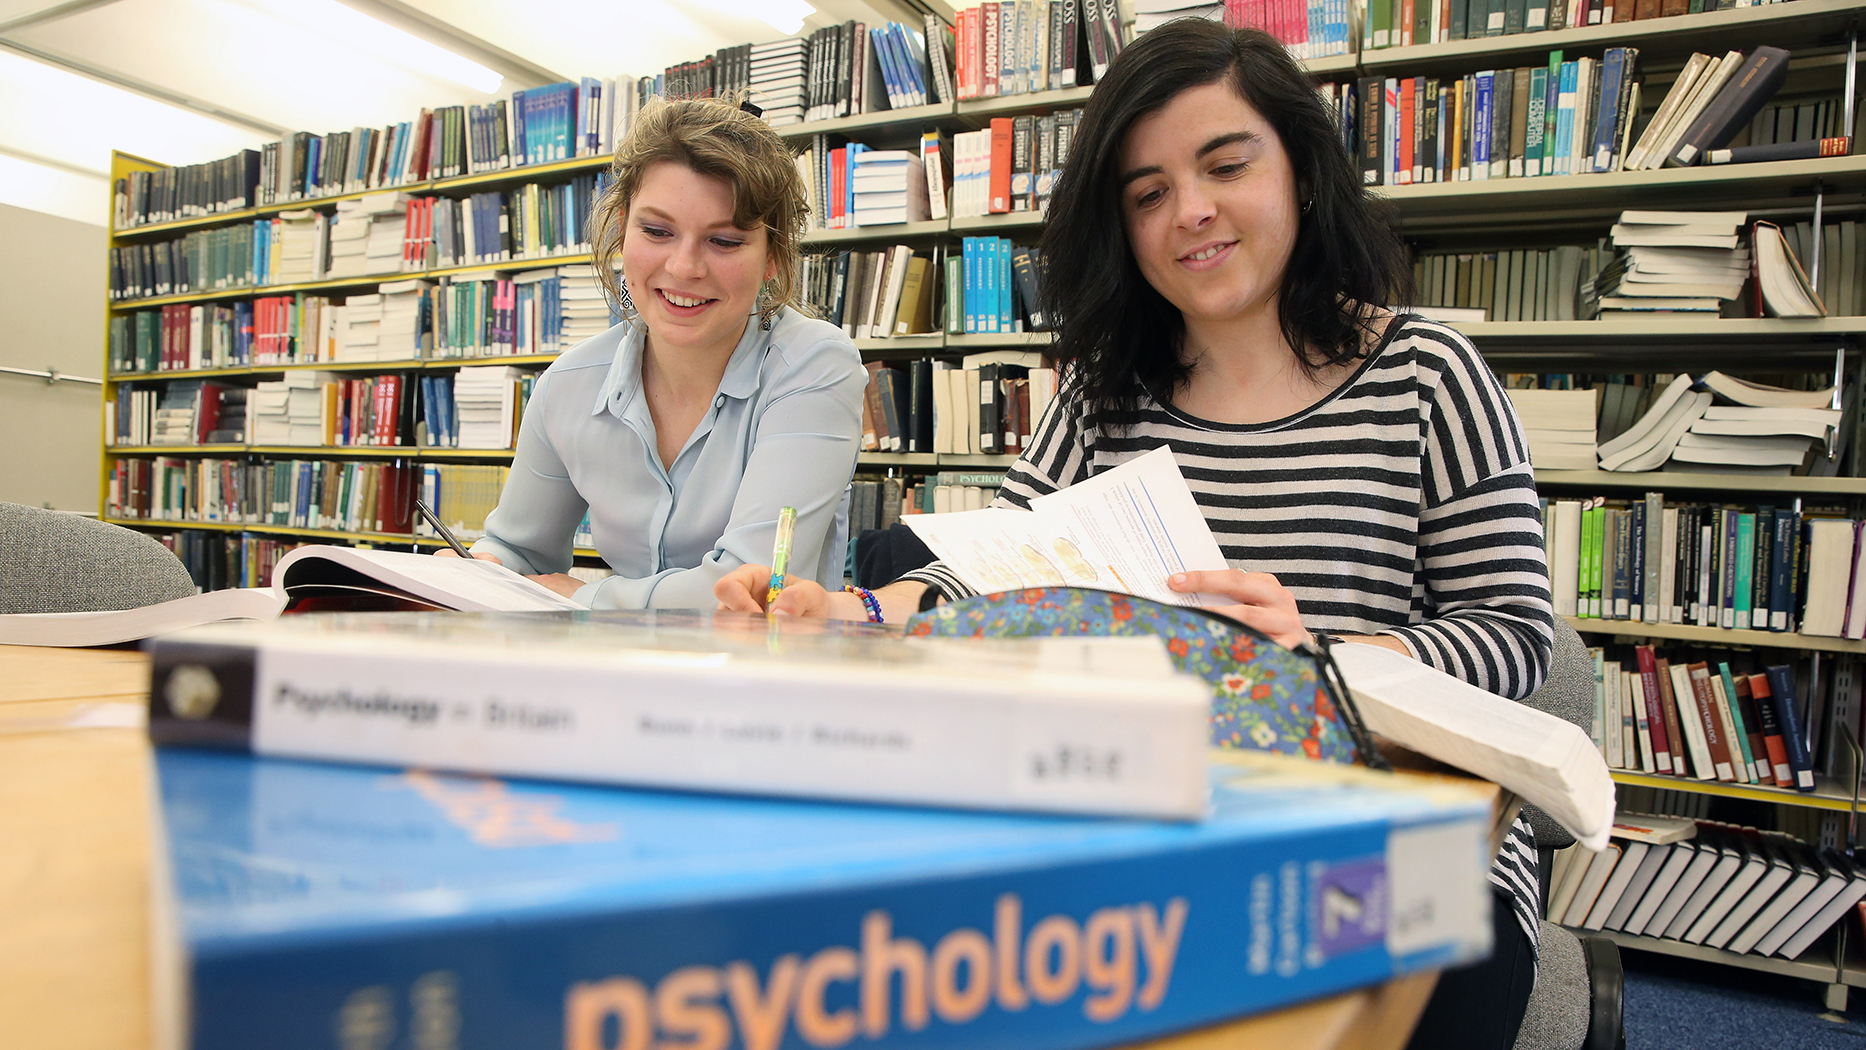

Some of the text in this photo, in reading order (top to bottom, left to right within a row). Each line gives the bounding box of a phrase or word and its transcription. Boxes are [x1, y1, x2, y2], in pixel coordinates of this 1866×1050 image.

[1063, 1, 1075, 24] OSS
[1085, 1, 1099, 23] OSS
[985, 12, 997, 79] PSYCHOLOGY
[1004, 10, 1014, 70] PSYCHOLOGY
[1527, 100, 1536, 147] COMPUTER
[1536, 100, 1545, 145] CEREBRAL
[967, 243, 972, 251] 1
[979, 243, 984, 251] 1
[989, 243, 995, 252] 2
[1002, 244, 1008, 252] 2
[272, 680, 440, 728] Psychology
[1321, 885, 1364, 940] 7
[564, 891, 1190, 1050] psychology
